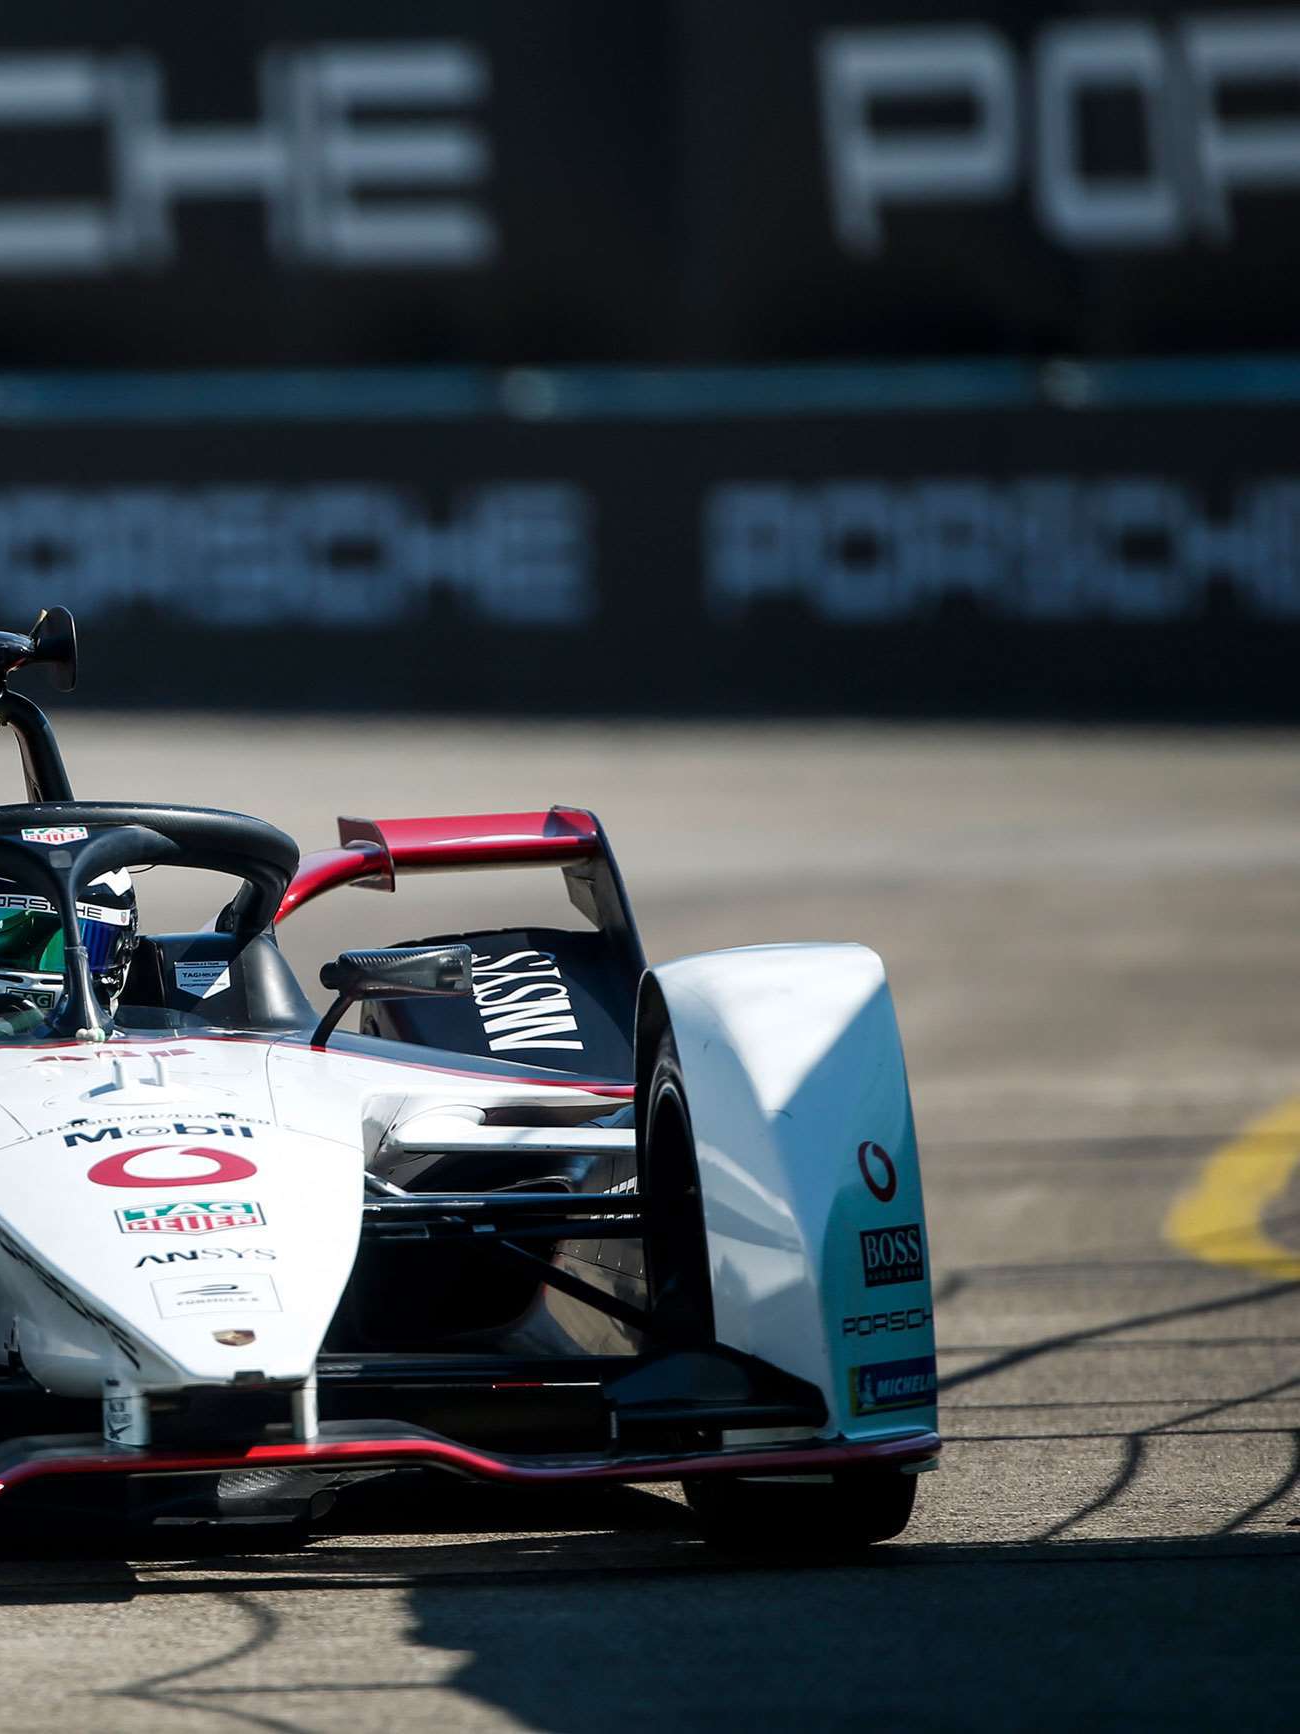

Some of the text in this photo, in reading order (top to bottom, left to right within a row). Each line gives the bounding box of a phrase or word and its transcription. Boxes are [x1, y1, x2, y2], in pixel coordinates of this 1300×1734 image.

[63, 1123, 254, 1148] Mobil
[124, 1201, 254, 1222] TAG
[127, 1214, 258, 1232] HEUER
[134, 1247, 277, 1269] ANSYS
[864, 1229, 920, 1268] BOSS
